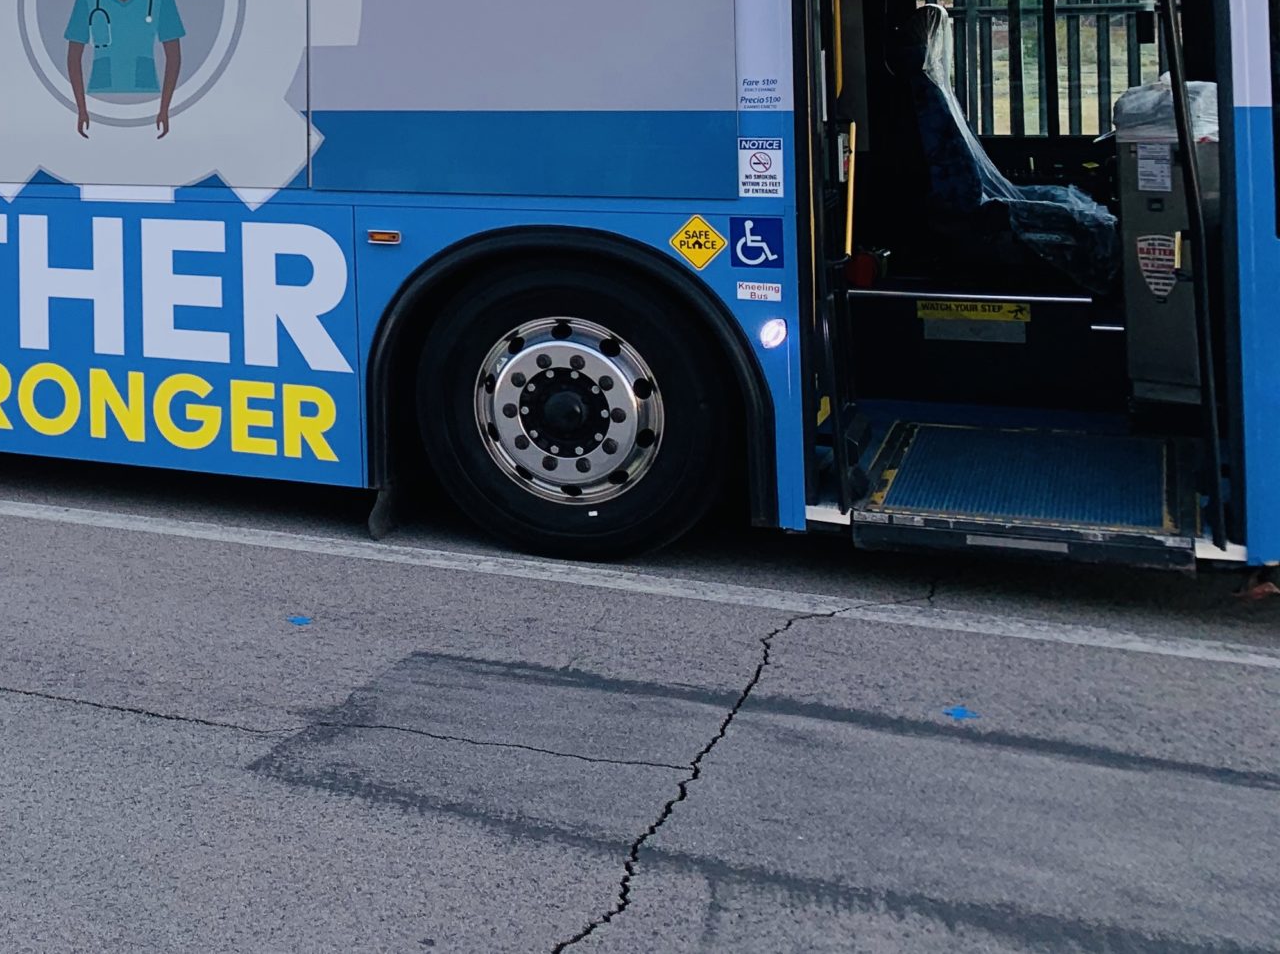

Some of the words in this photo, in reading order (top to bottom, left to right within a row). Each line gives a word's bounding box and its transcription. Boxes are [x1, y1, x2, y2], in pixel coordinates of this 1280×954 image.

[742, 78, 760, 86] Fare
[740, 96, 765, 104] Precio
[741, 140, 781, 149] NOTICE
[685, 230, 710, 240] SAFE
[738, 282, 780, 294] Kneeling
[750, 292, 768, 300] Bus
[921, 303, 952, 311] WATCH
[955, 304, 978, 312] YOUR
[981, 304, 1003, 313] STEP
